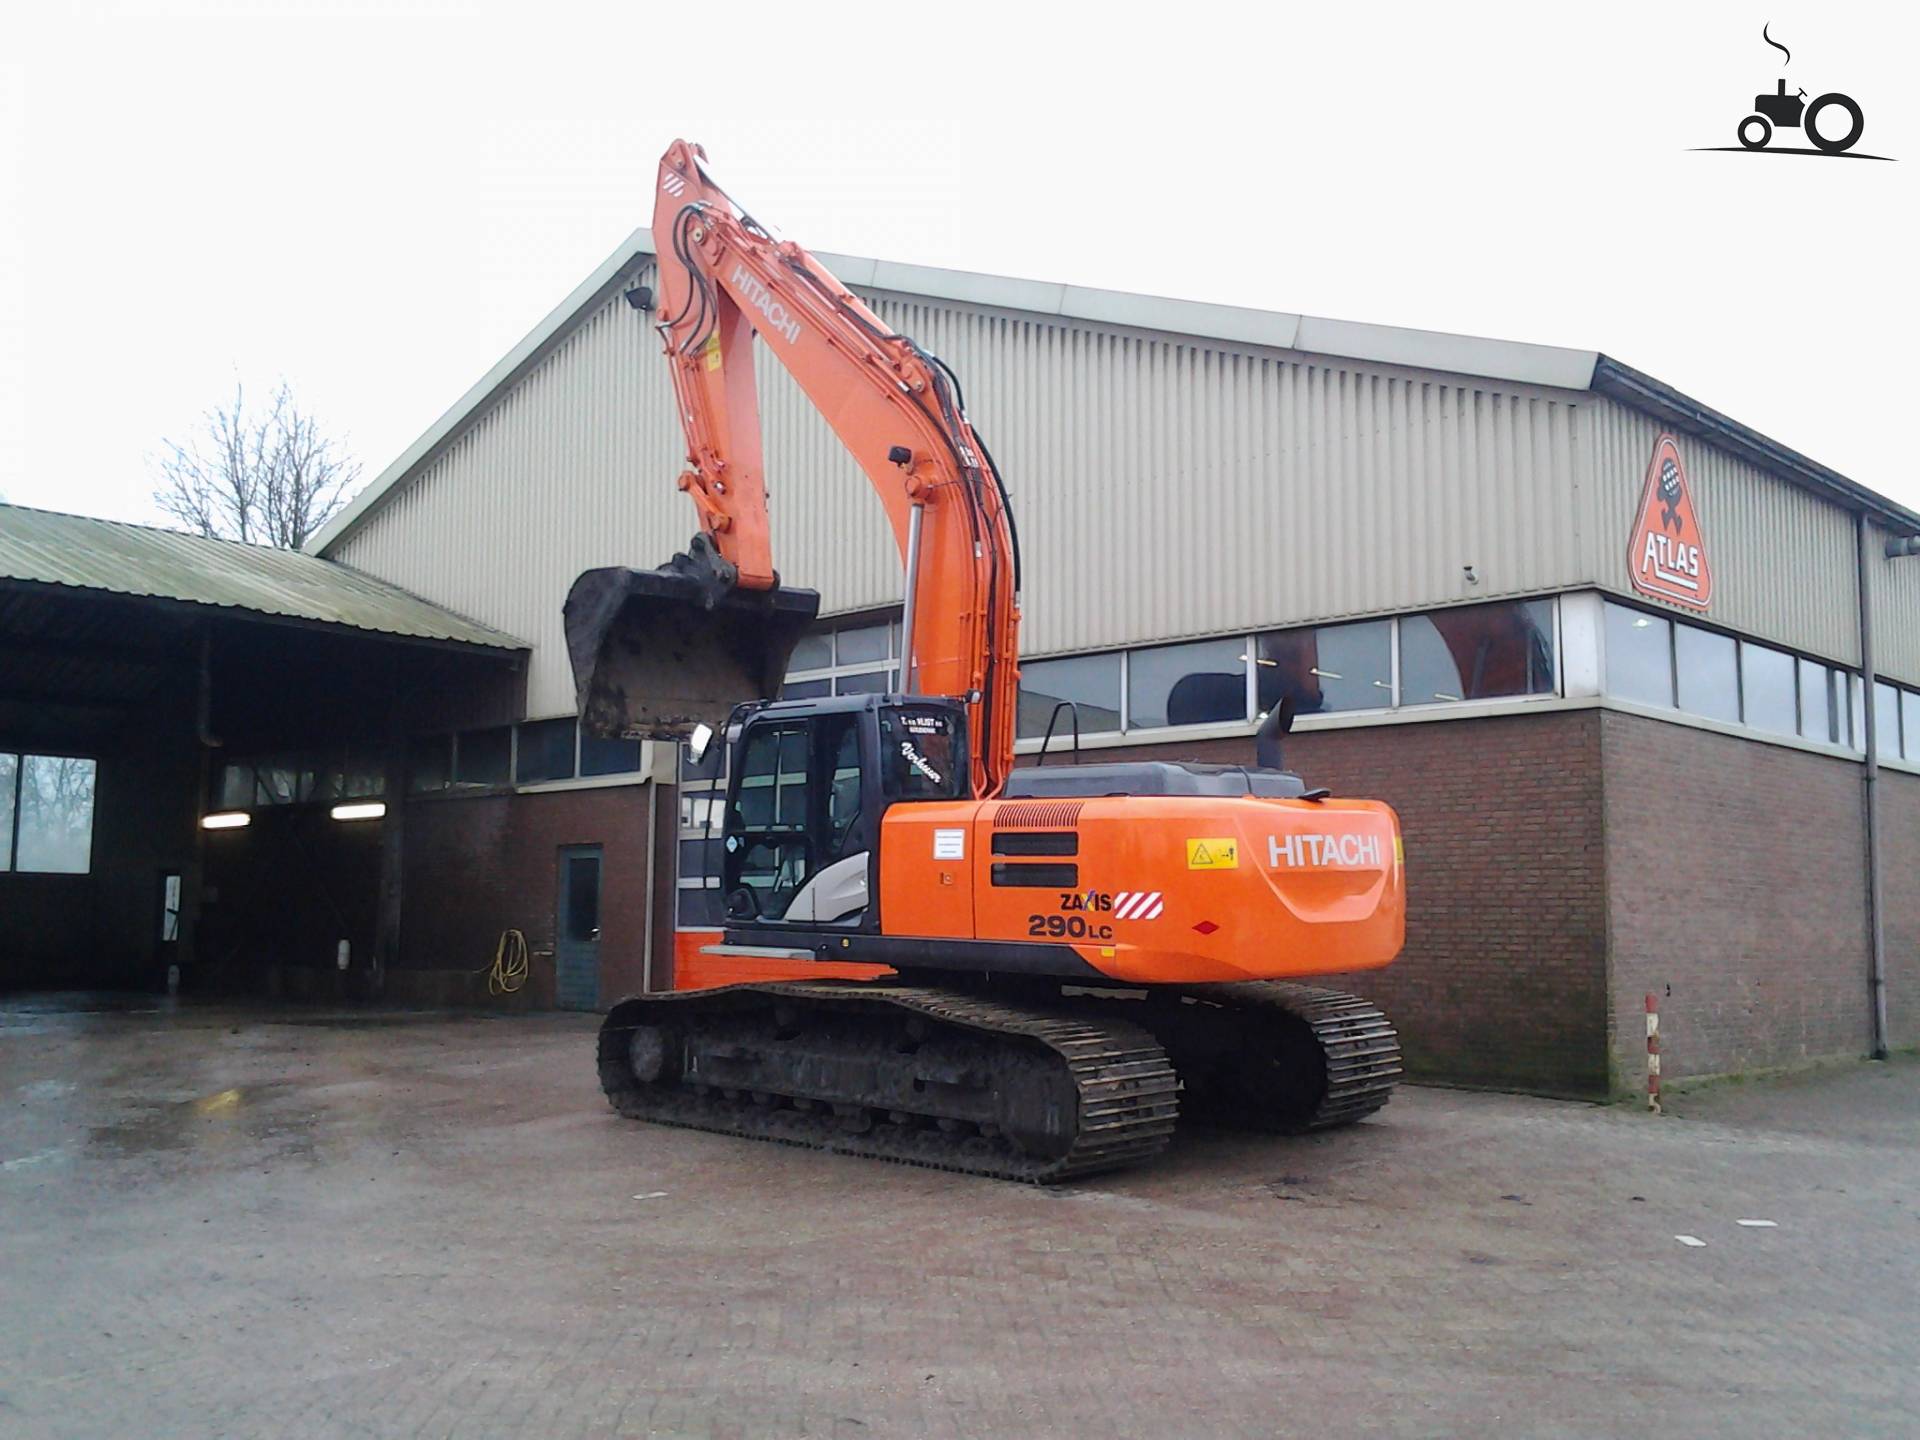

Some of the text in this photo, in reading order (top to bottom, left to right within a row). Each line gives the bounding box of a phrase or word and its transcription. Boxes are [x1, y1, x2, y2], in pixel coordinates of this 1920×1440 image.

[732, 264, 800, 344] HITACHI
[1642, 531, 1698, 590] ATLAS
[1268, 834, 1380, 867] HITACHI
[1060, 890, 1112, 912] ZAXIS
[1028, 914, 1113, 939] 290 LC
